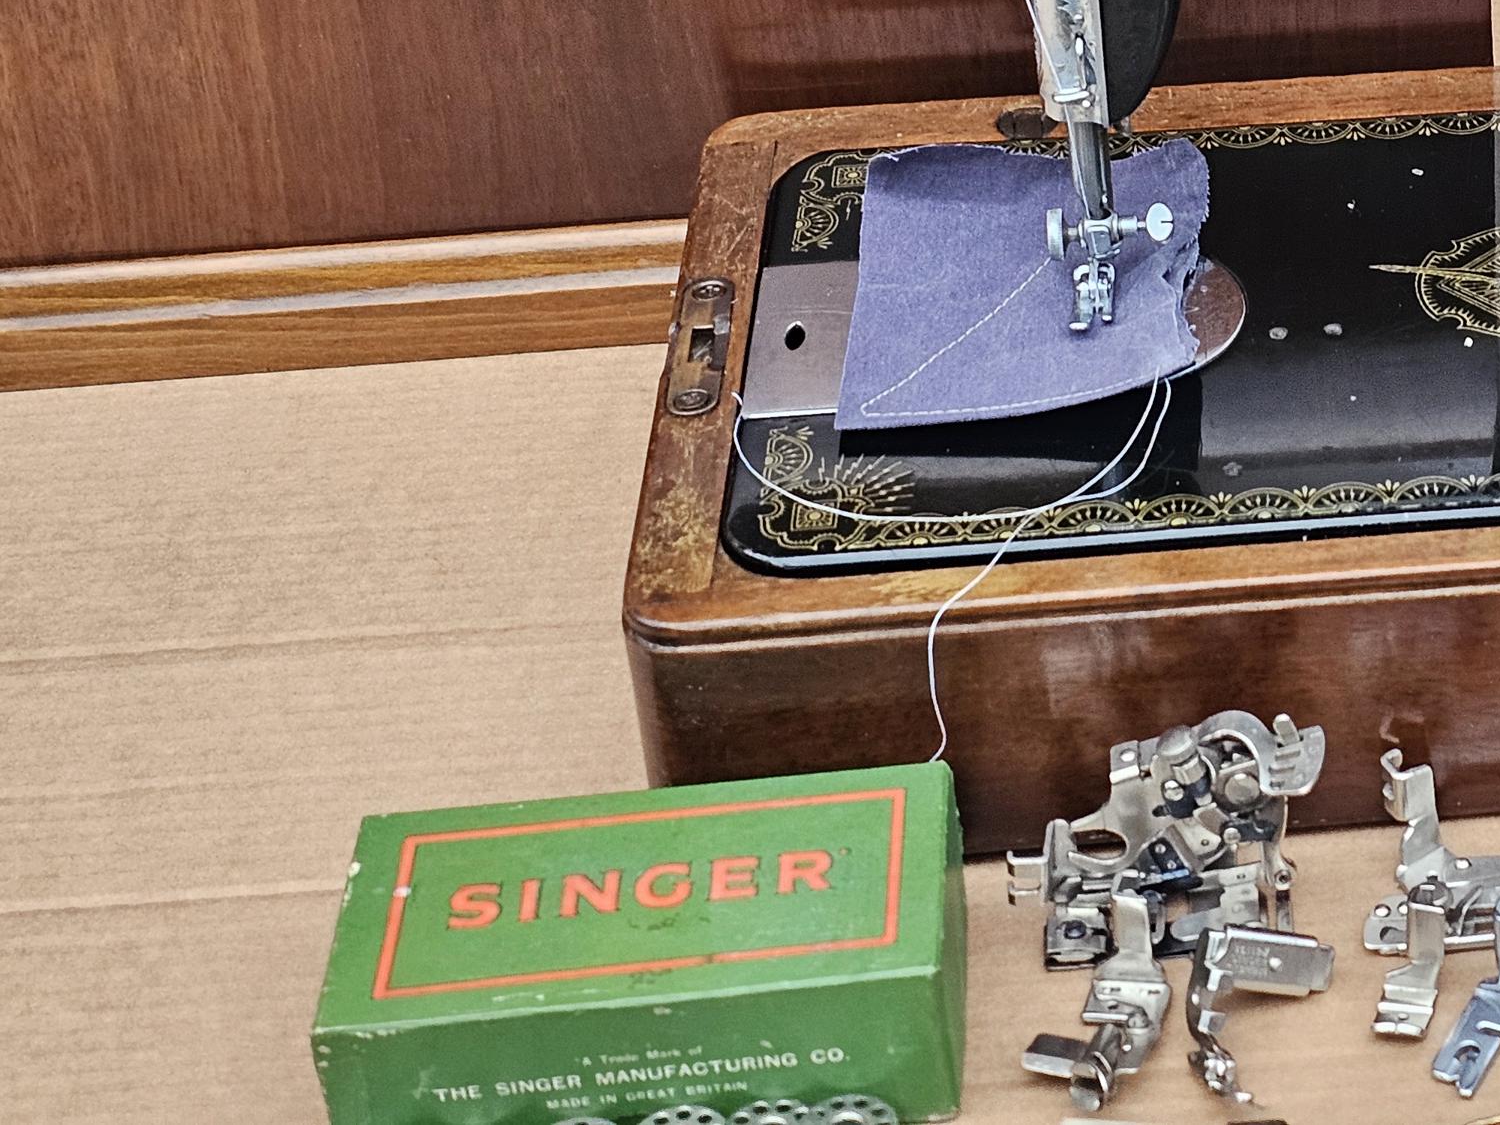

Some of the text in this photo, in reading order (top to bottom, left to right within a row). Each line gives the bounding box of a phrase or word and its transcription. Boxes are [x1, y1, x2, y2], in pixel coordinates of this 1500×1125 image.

[449, 849, 834, 929] SINGER
[646, 1048, 681, 1060] Mark
[687, 1046, 703, 1056] of
[432, 1085, 483, 1103] THE
[494, 1074, 582, 1096] SINGER
[595, 1052, 798, 1086] MANUFACTURING
[546, 1081, 748, 1110] MADE IN GREAT BRITAIN
